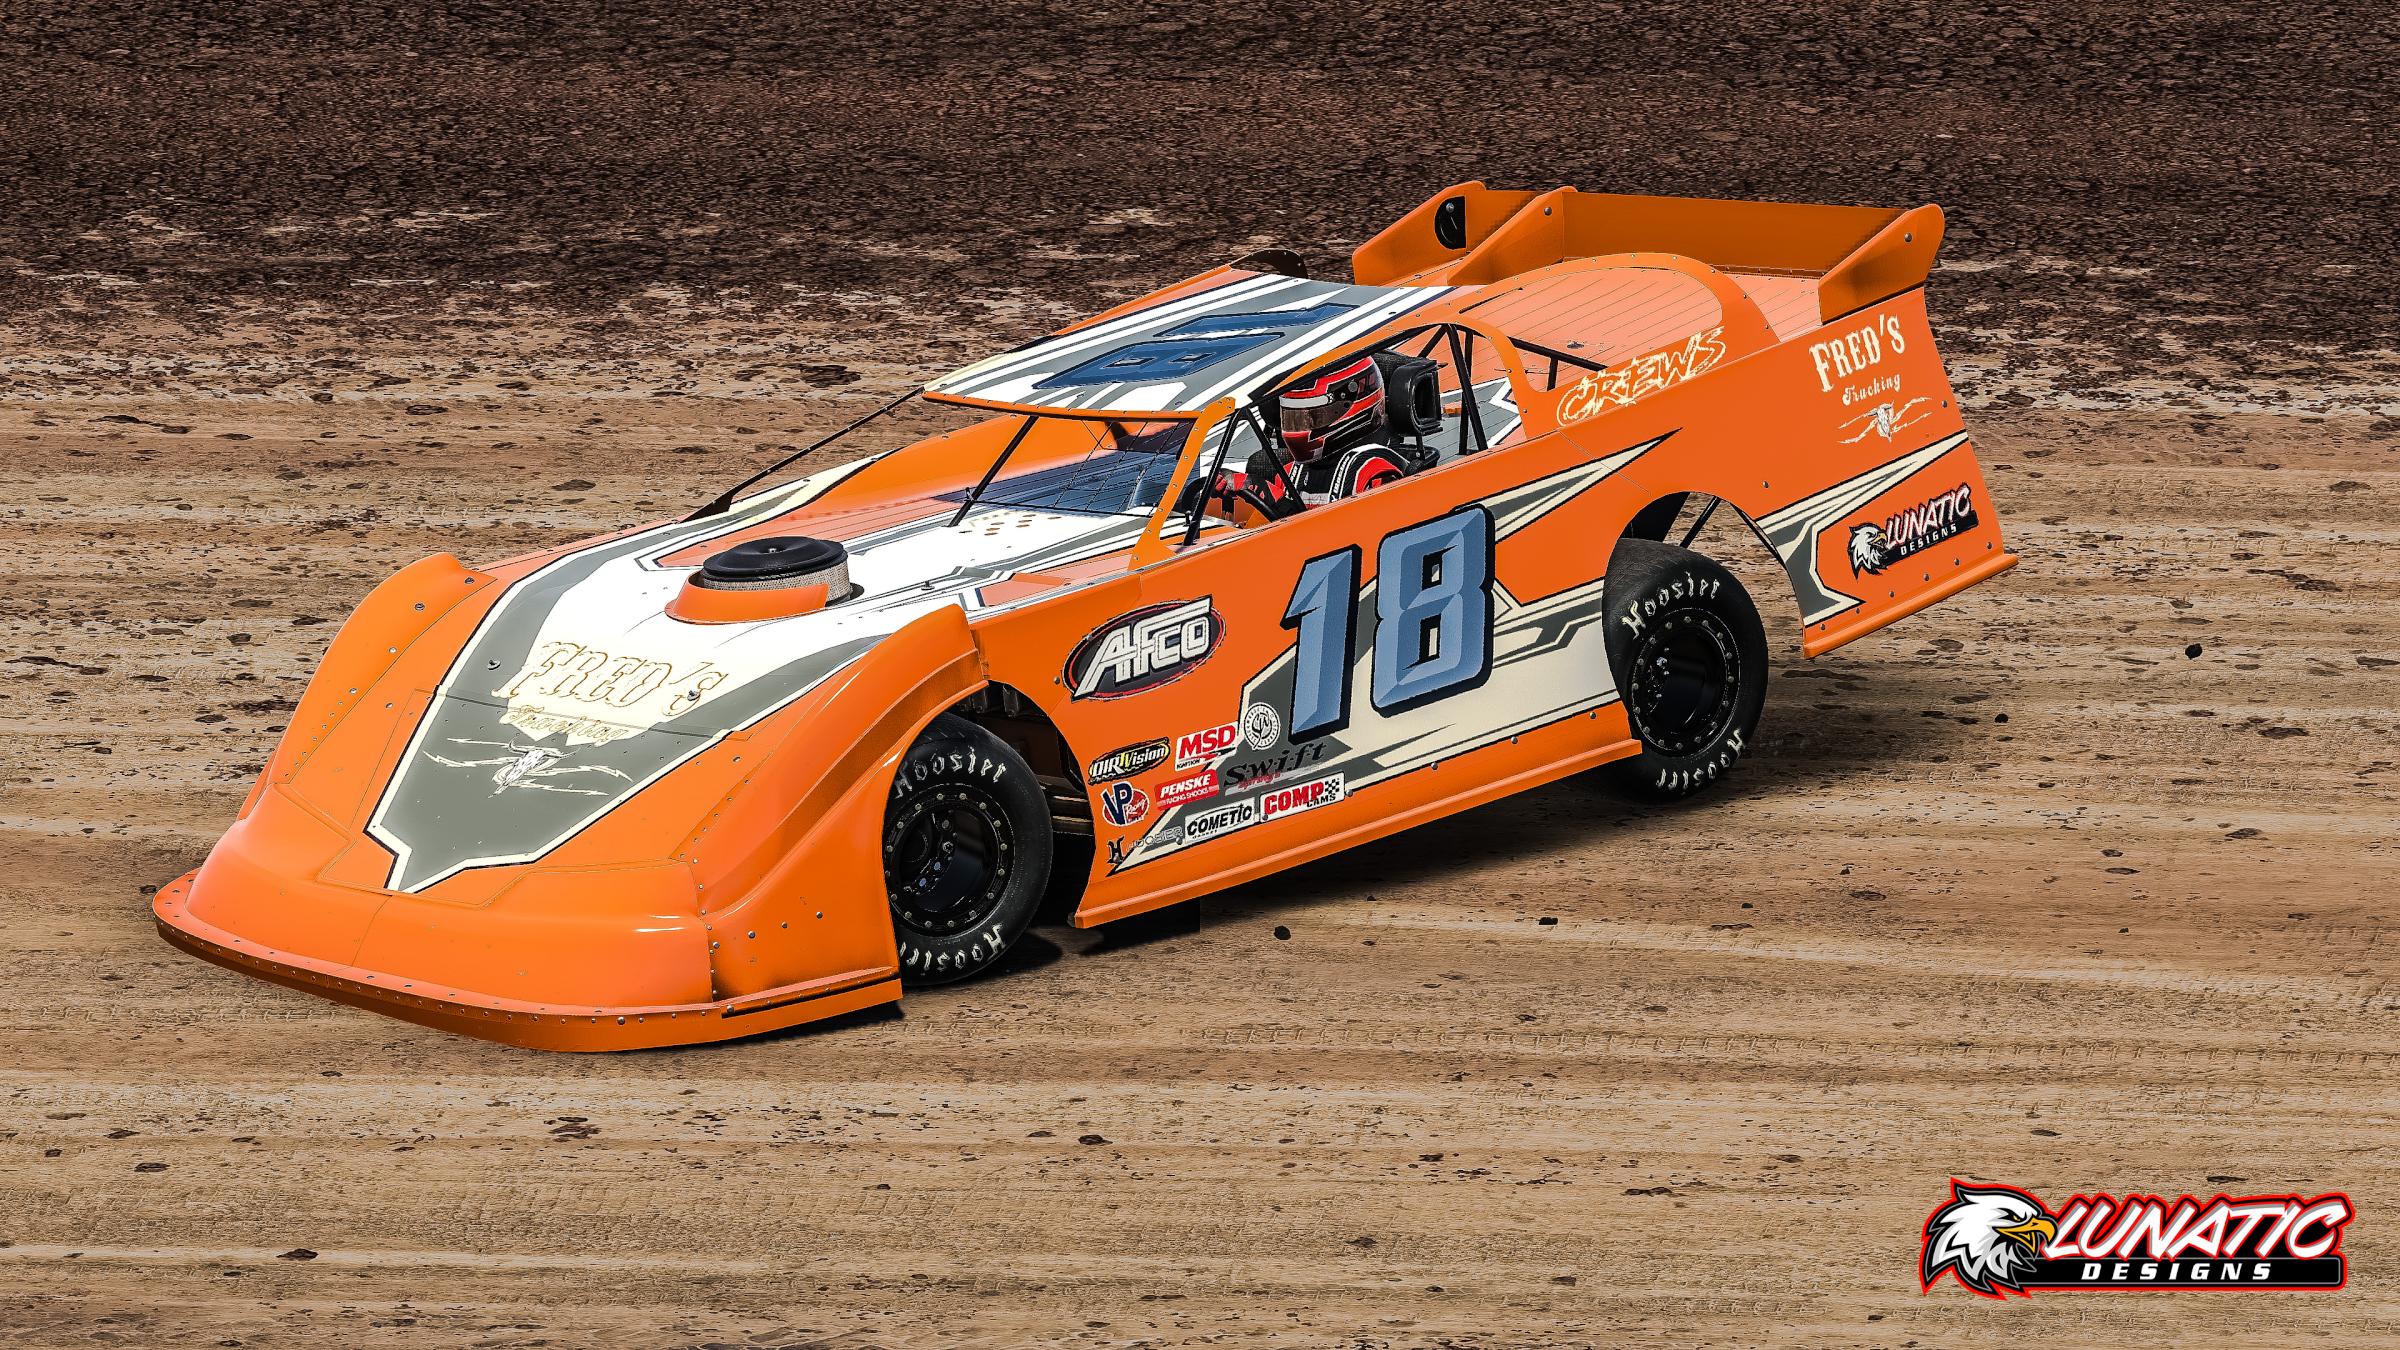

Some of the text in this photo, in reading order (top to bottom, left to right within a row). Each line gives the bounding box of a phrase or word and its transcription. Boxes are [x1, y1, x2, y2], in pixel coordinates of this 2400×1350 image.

[1556, 326, 1726, 427] CREWS
[1808, 313, 1905, 392] FRED'S
[1842, 374, 1901, 406] Trucking
[1885, 484, 1971, 550] LUNATIC
[1900, 523, 1957, 556] DESIGNS
[1280, 503, 1495, 745] 18
[1621, 571, 1721, 640] Hoosier
[1072, 596, 1212, 701] AFCO
[491, 641, 729, 717] FRED'S
[1179, 725, 1236, 760] MSD
[1656, 728, 1746, 792] Hoosier
[1101, 781, 1134, 826] VP
[1160, 774, 1212, 799] PENSKE
[1263, 781, 1325, 816] COMP
[1306, 792, 1337, 808] CAMS
[1187, 803, 1253, 837] COMETIC
